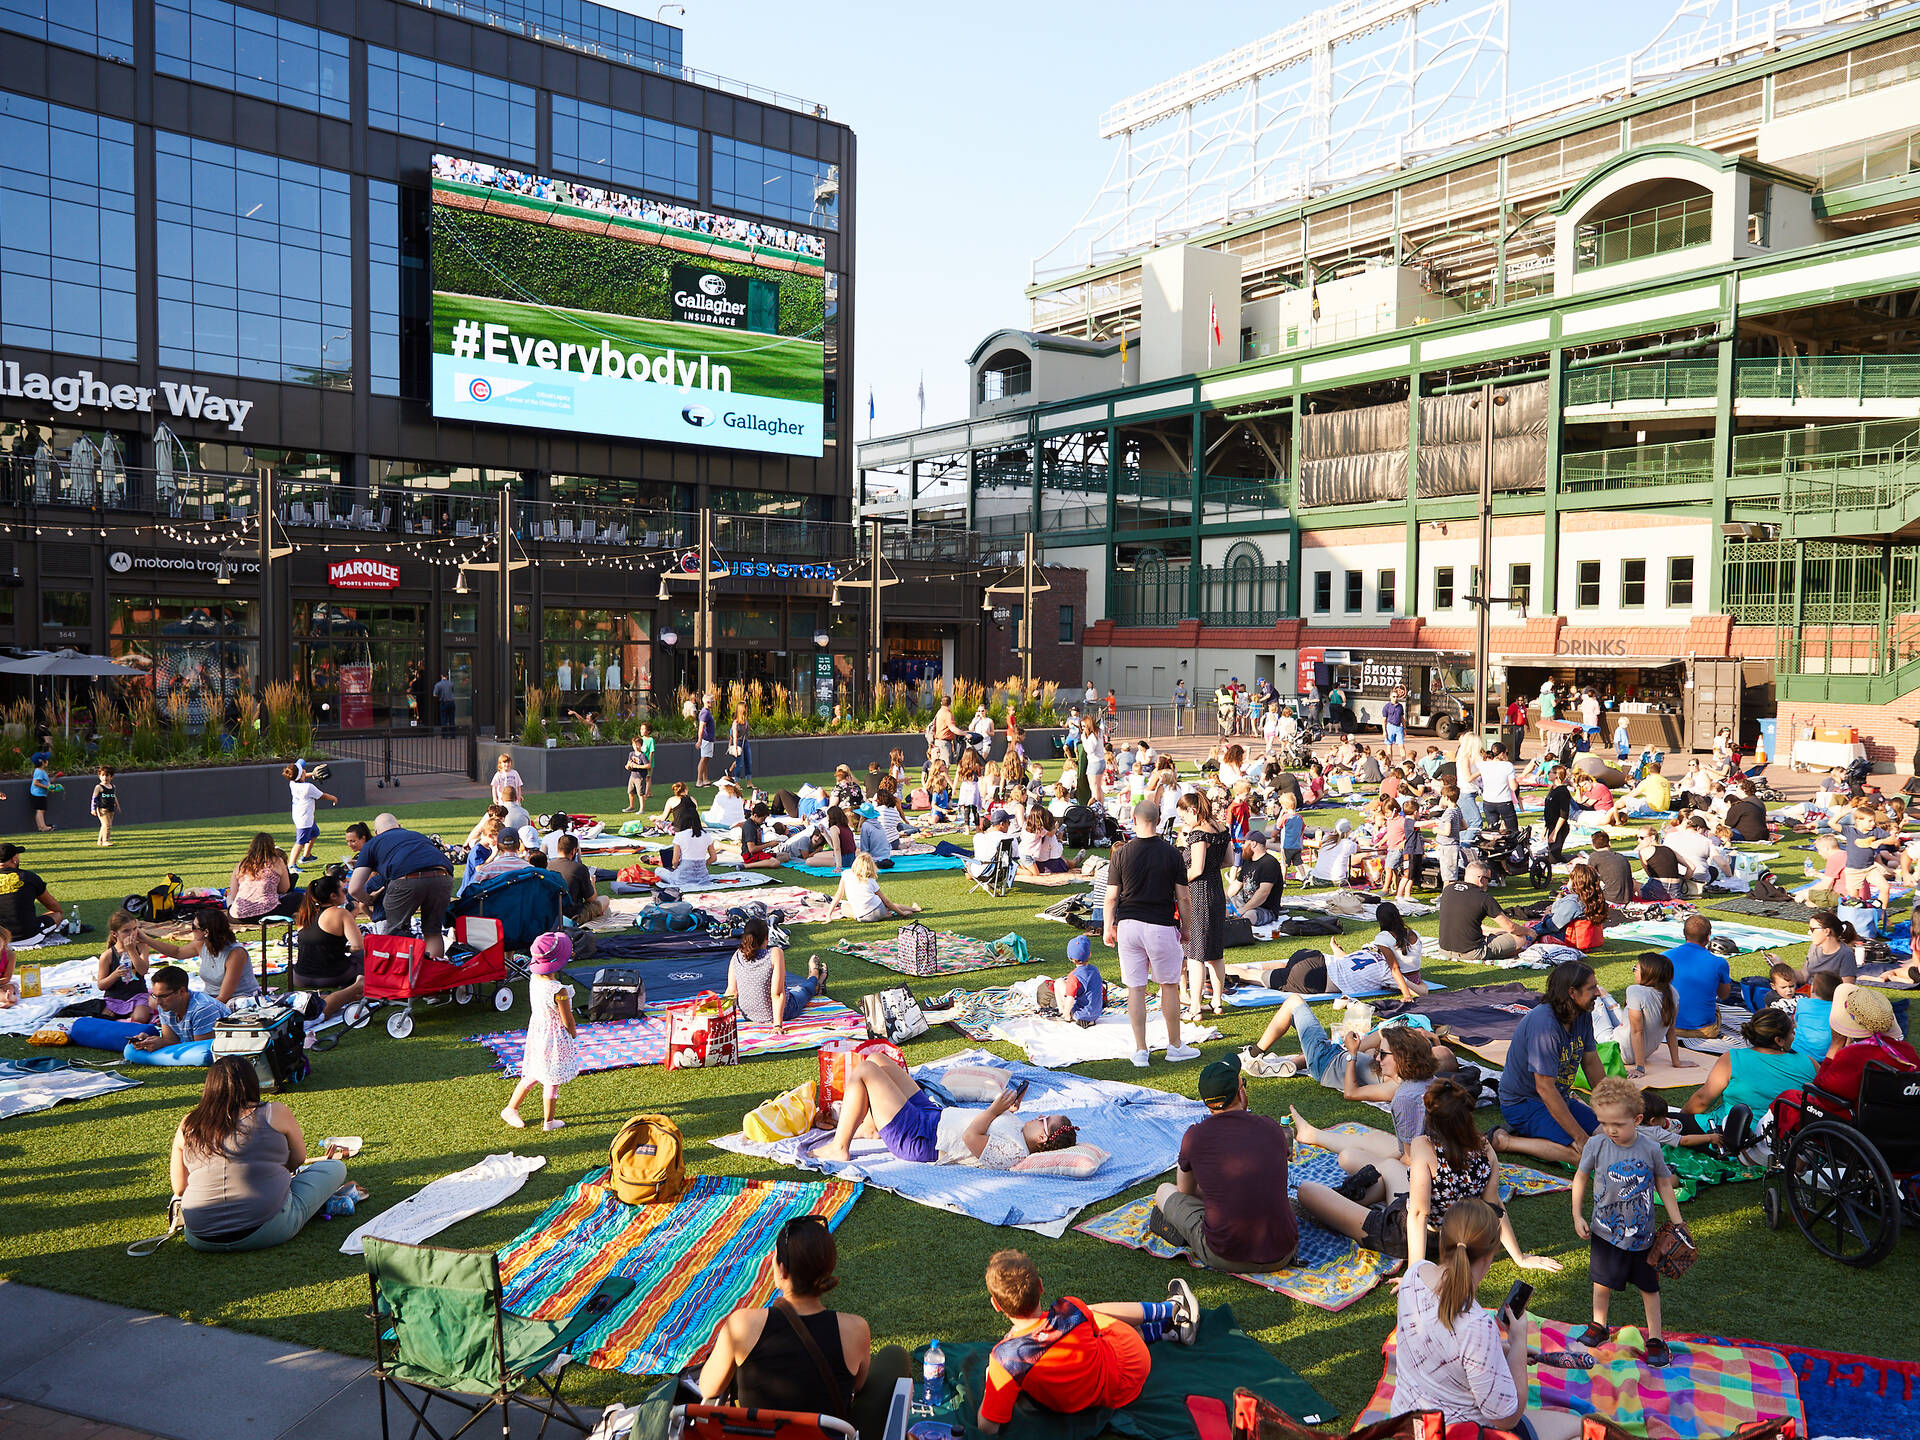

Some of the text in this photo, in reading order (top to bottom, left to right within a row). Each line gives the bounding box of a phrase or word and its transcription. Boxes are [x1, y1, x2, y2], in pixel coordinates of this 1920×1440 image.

[674, 291, 746, 316] Gallagher
[683, 311, 736, 327] INSURANCE
[451, 319, 732, 395] #EverybodyIn
[160, 382, 253, 432] Way
[723, 412, 804, 436] Gallagher
[134, 557, 195, 570] motorola
[242, 563, 260, 573] roo
[331, 561, 398, 581] MARQUEE
[776, 563, 836, 580] STORE
[1557, 639, 1626, 656] DRINKS
[1364, 665, 1402, 676] SMOKE
[1364, 675, 1402, 687] DADDY
[1806, 1105, 1824, 1118] drive
